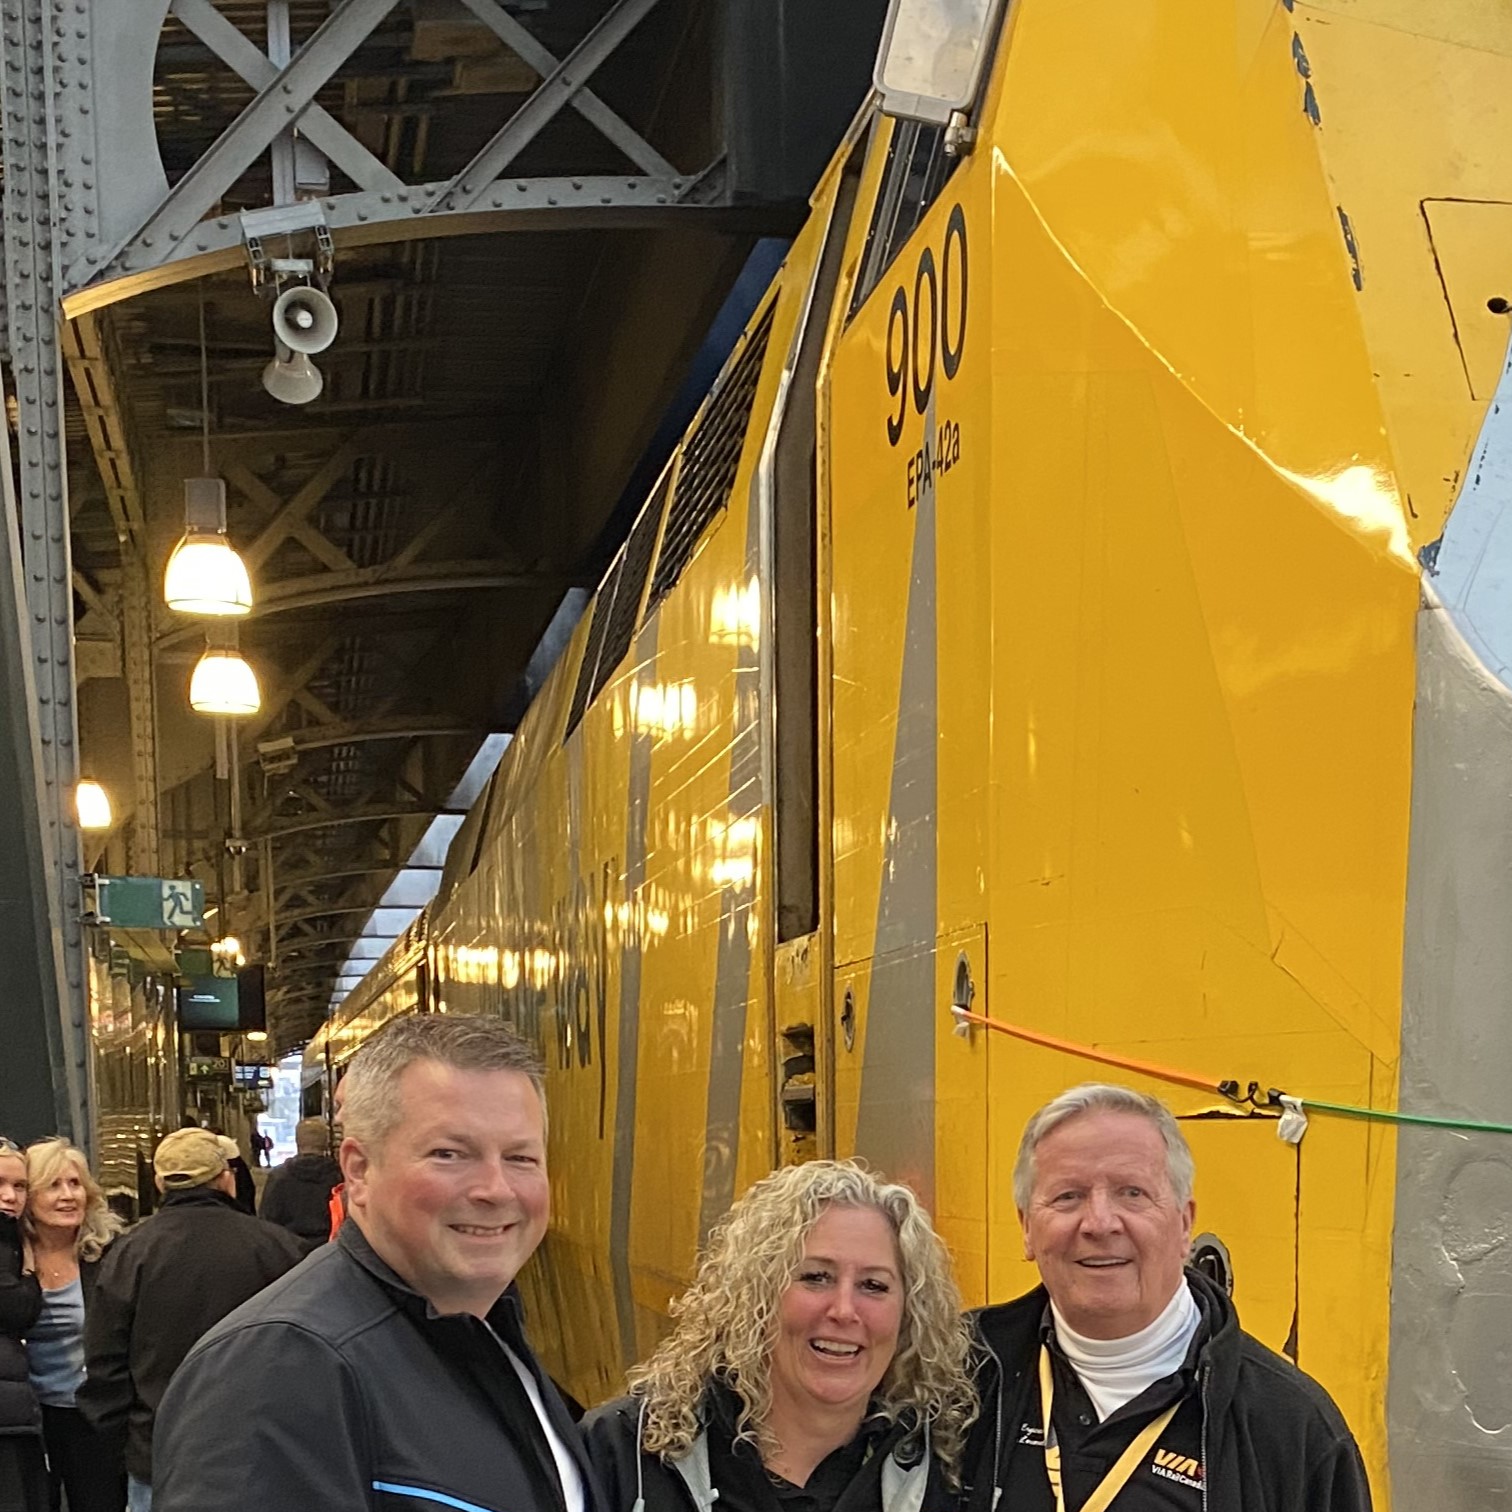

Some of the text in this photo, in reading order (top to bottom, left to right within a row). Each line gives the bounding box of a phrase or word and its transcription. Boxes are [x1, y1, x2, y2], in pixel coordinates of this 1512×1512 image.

[886, 203, 968, 447] 900
[907, 419, 960, 510] EPA-42a
[1154, 1449, 1199, 1477] VIA
